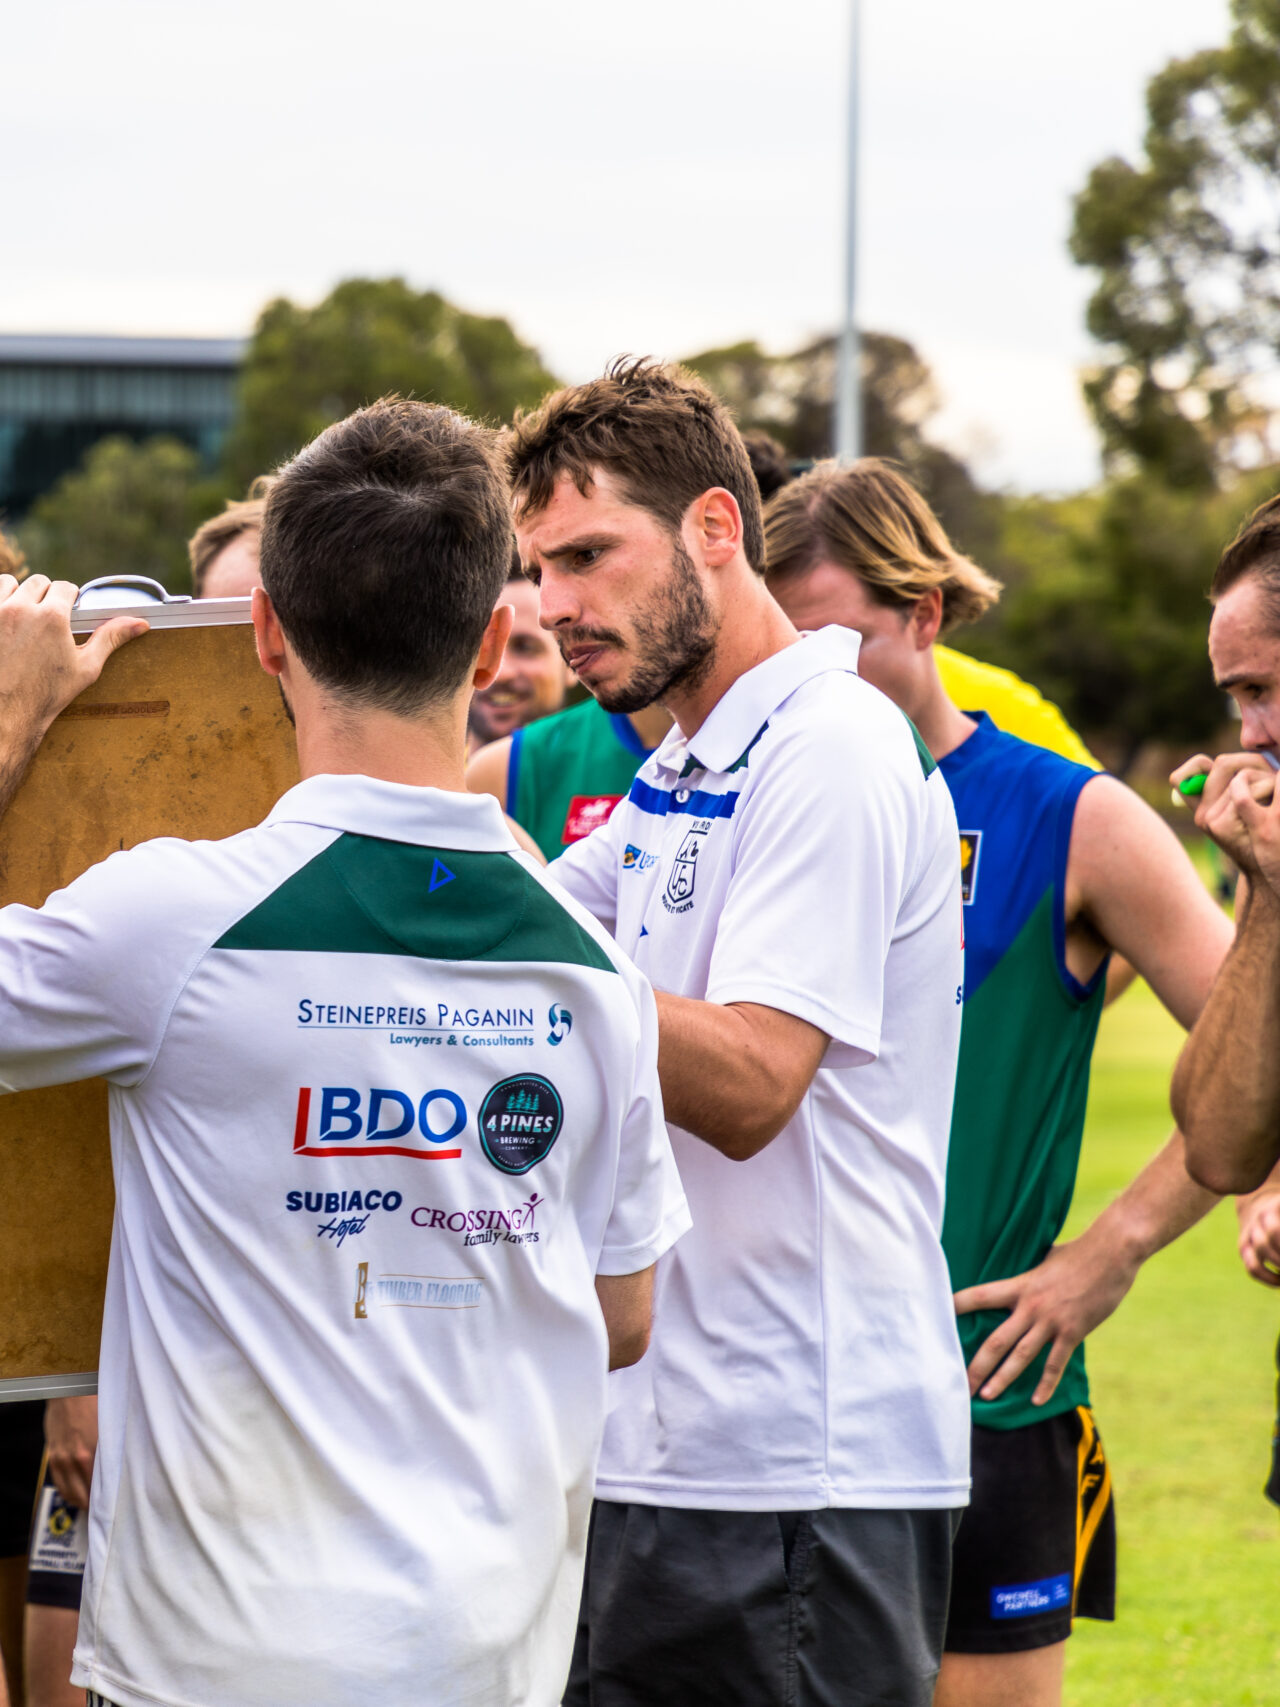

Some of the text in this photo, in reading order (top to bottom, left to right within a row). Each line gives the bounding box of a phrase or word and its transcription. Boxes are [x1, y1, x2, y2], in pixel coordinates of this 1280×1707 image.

[298, 999, 534, 1027] STEINEPREIS PAGANIN
[390, 1033, 535, 1048] Lawyers & Consultants
[320, 1087, 468, 1144] BDO
[486, 1114, 554, 1133] 4 PINES
[500, 1136, 535, 1145] BREWING
[286, 1190, 403, 1214] SUBIACO
[317, 1213, 370, 1248] Hotel
[410, 1206, 523, 1233] CROSSING
[463, 1229, 502, 1247] family
